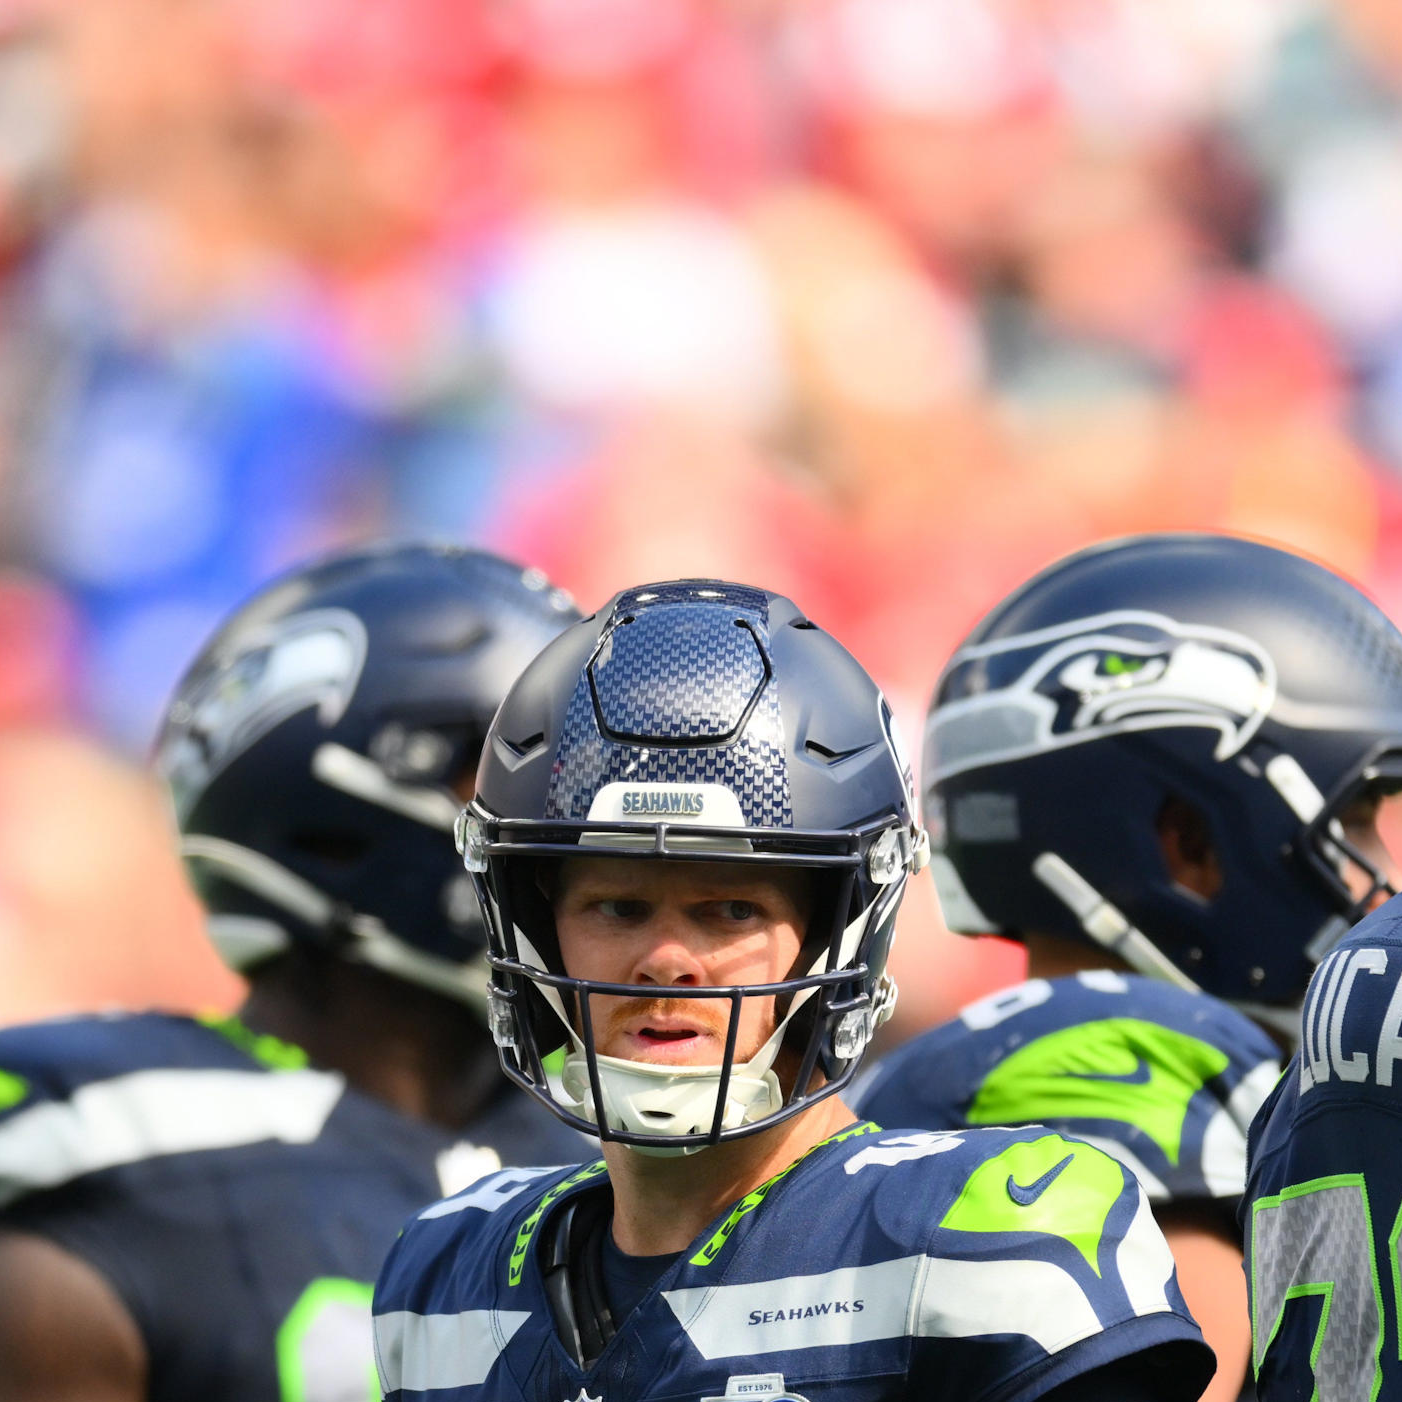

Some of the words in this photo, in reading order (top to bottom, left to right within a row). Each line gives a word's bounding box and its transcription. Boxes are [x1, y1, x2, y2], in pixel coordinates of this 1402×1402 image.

[622, 791, 704, 815] SEAHAWKS
[748, 1299, 864, 1326] SEAHAWKS
[737, 1385, 753, 1393] EST
[754, 1383, 773, 1392] 1976
